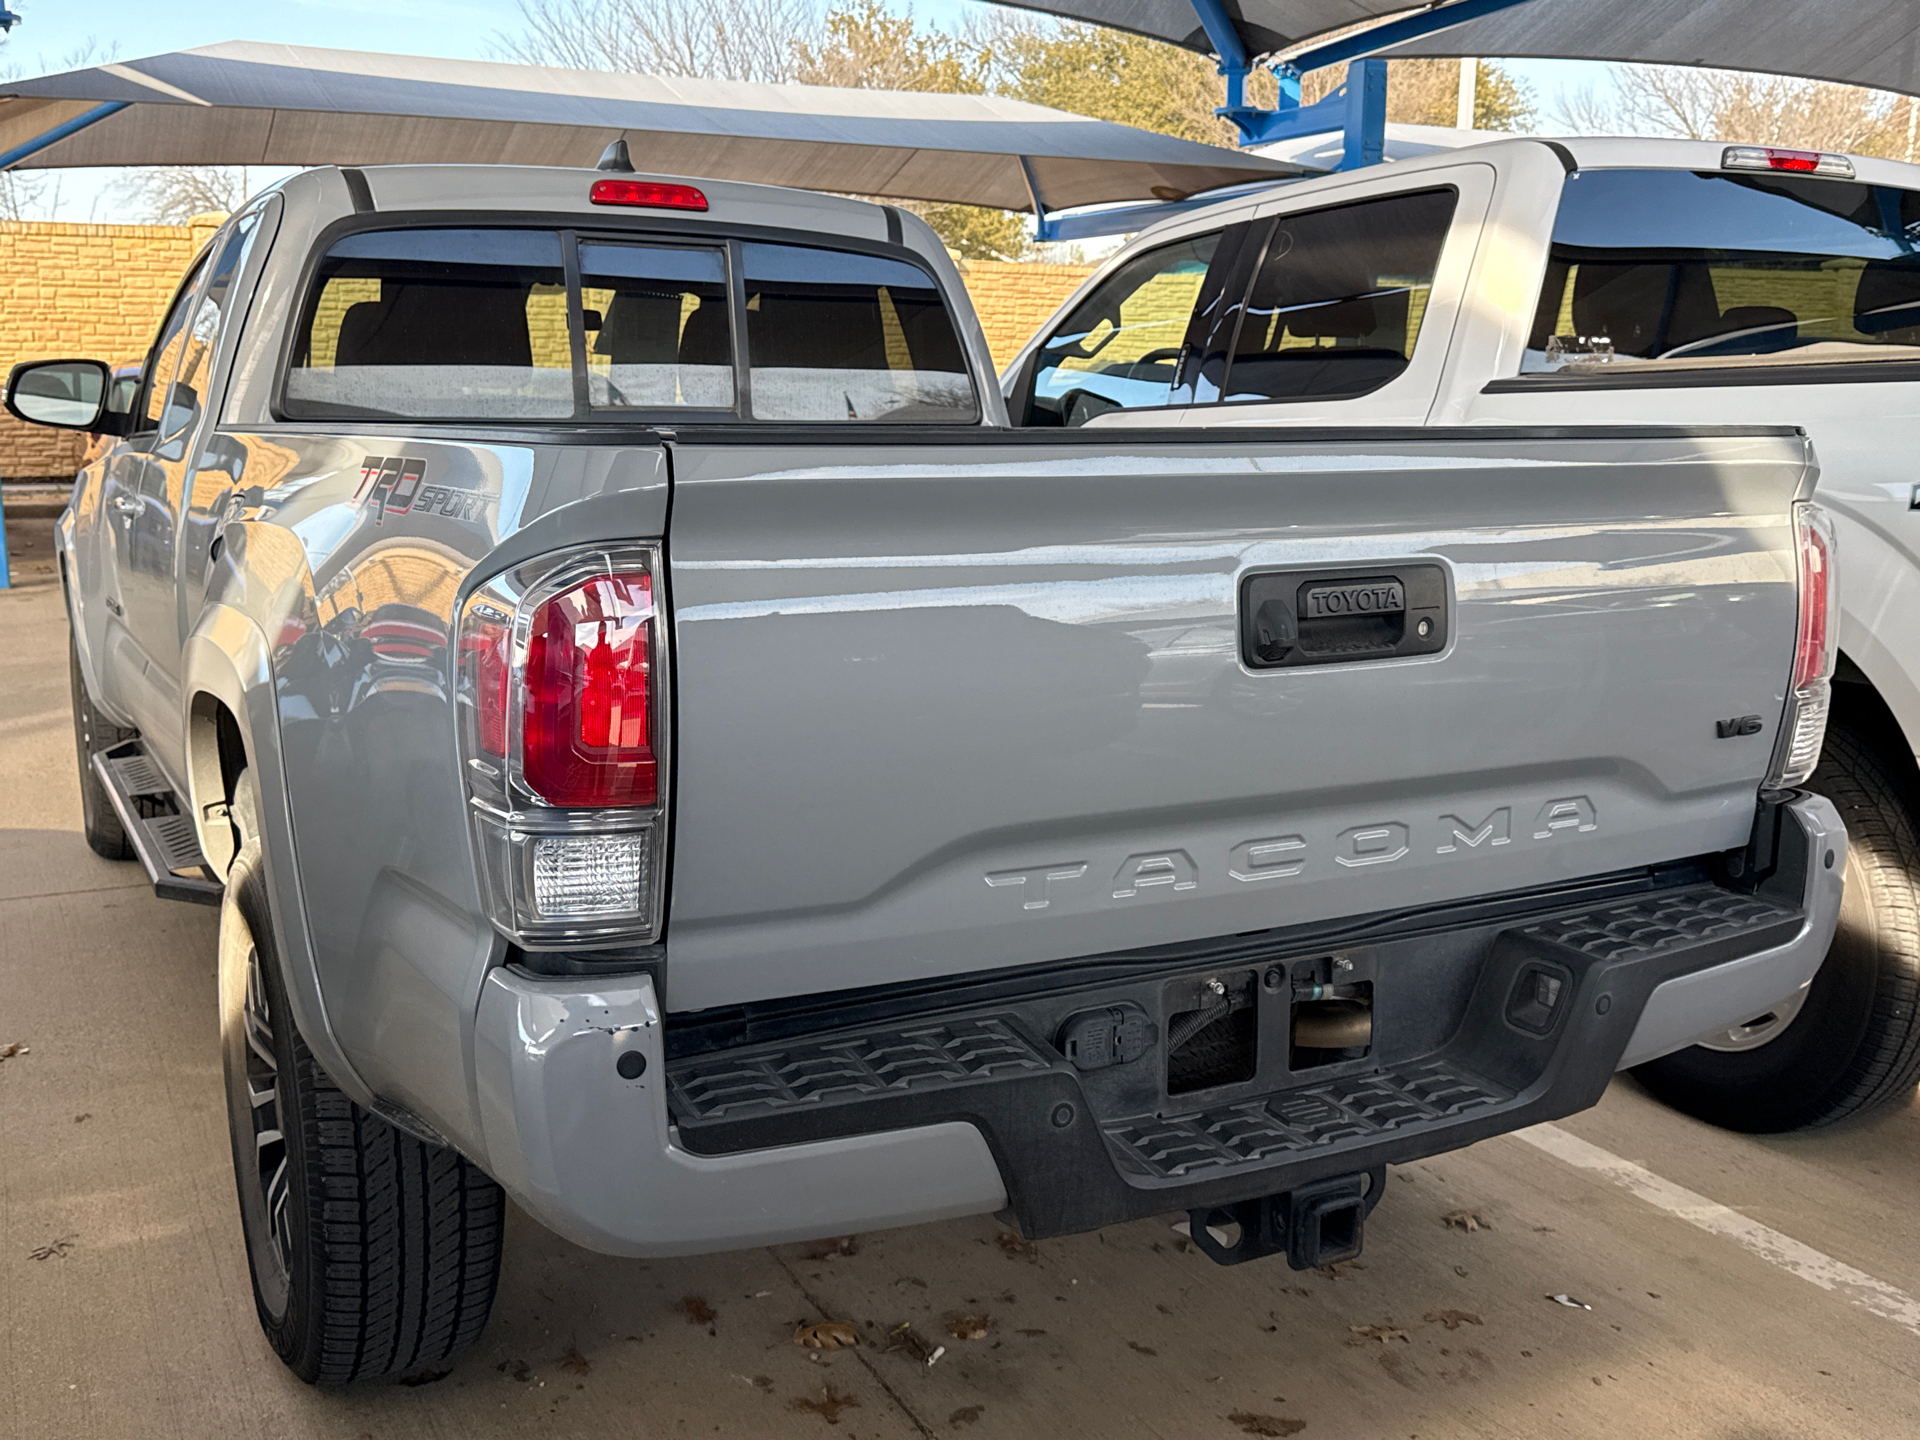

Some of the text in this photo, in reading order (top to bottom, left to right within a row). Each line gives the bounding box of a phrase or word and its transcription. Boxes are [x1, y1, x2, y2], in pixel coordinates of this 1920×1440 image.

[352, 455, 501, 527] TRD SPORT
[1312, 587, 1400, 613] TOYOTA
[1716, 714, 1762, 738] V6
[985, 794, 1597, 909] TACOMA
